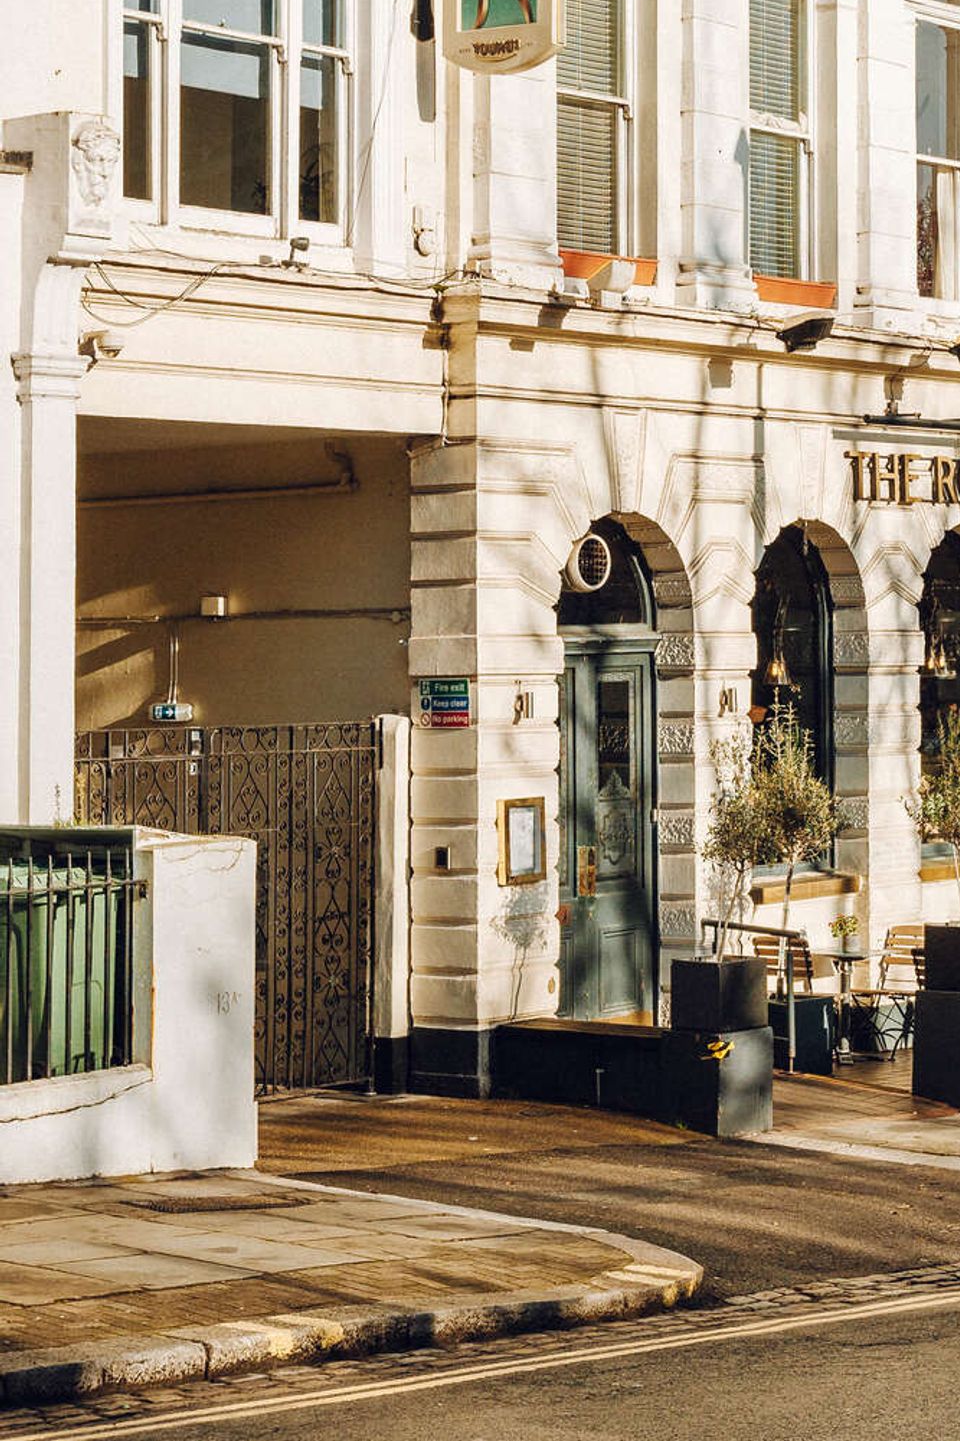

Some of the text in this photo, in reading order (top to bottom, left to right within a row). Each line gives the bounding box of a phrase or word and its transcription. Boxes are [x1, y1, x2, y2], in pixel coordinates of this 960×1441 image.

[843, 451, 922, 506] THE
[433, 700, 467, 708] Keep clear
[442, 715, 468, 724] parking
